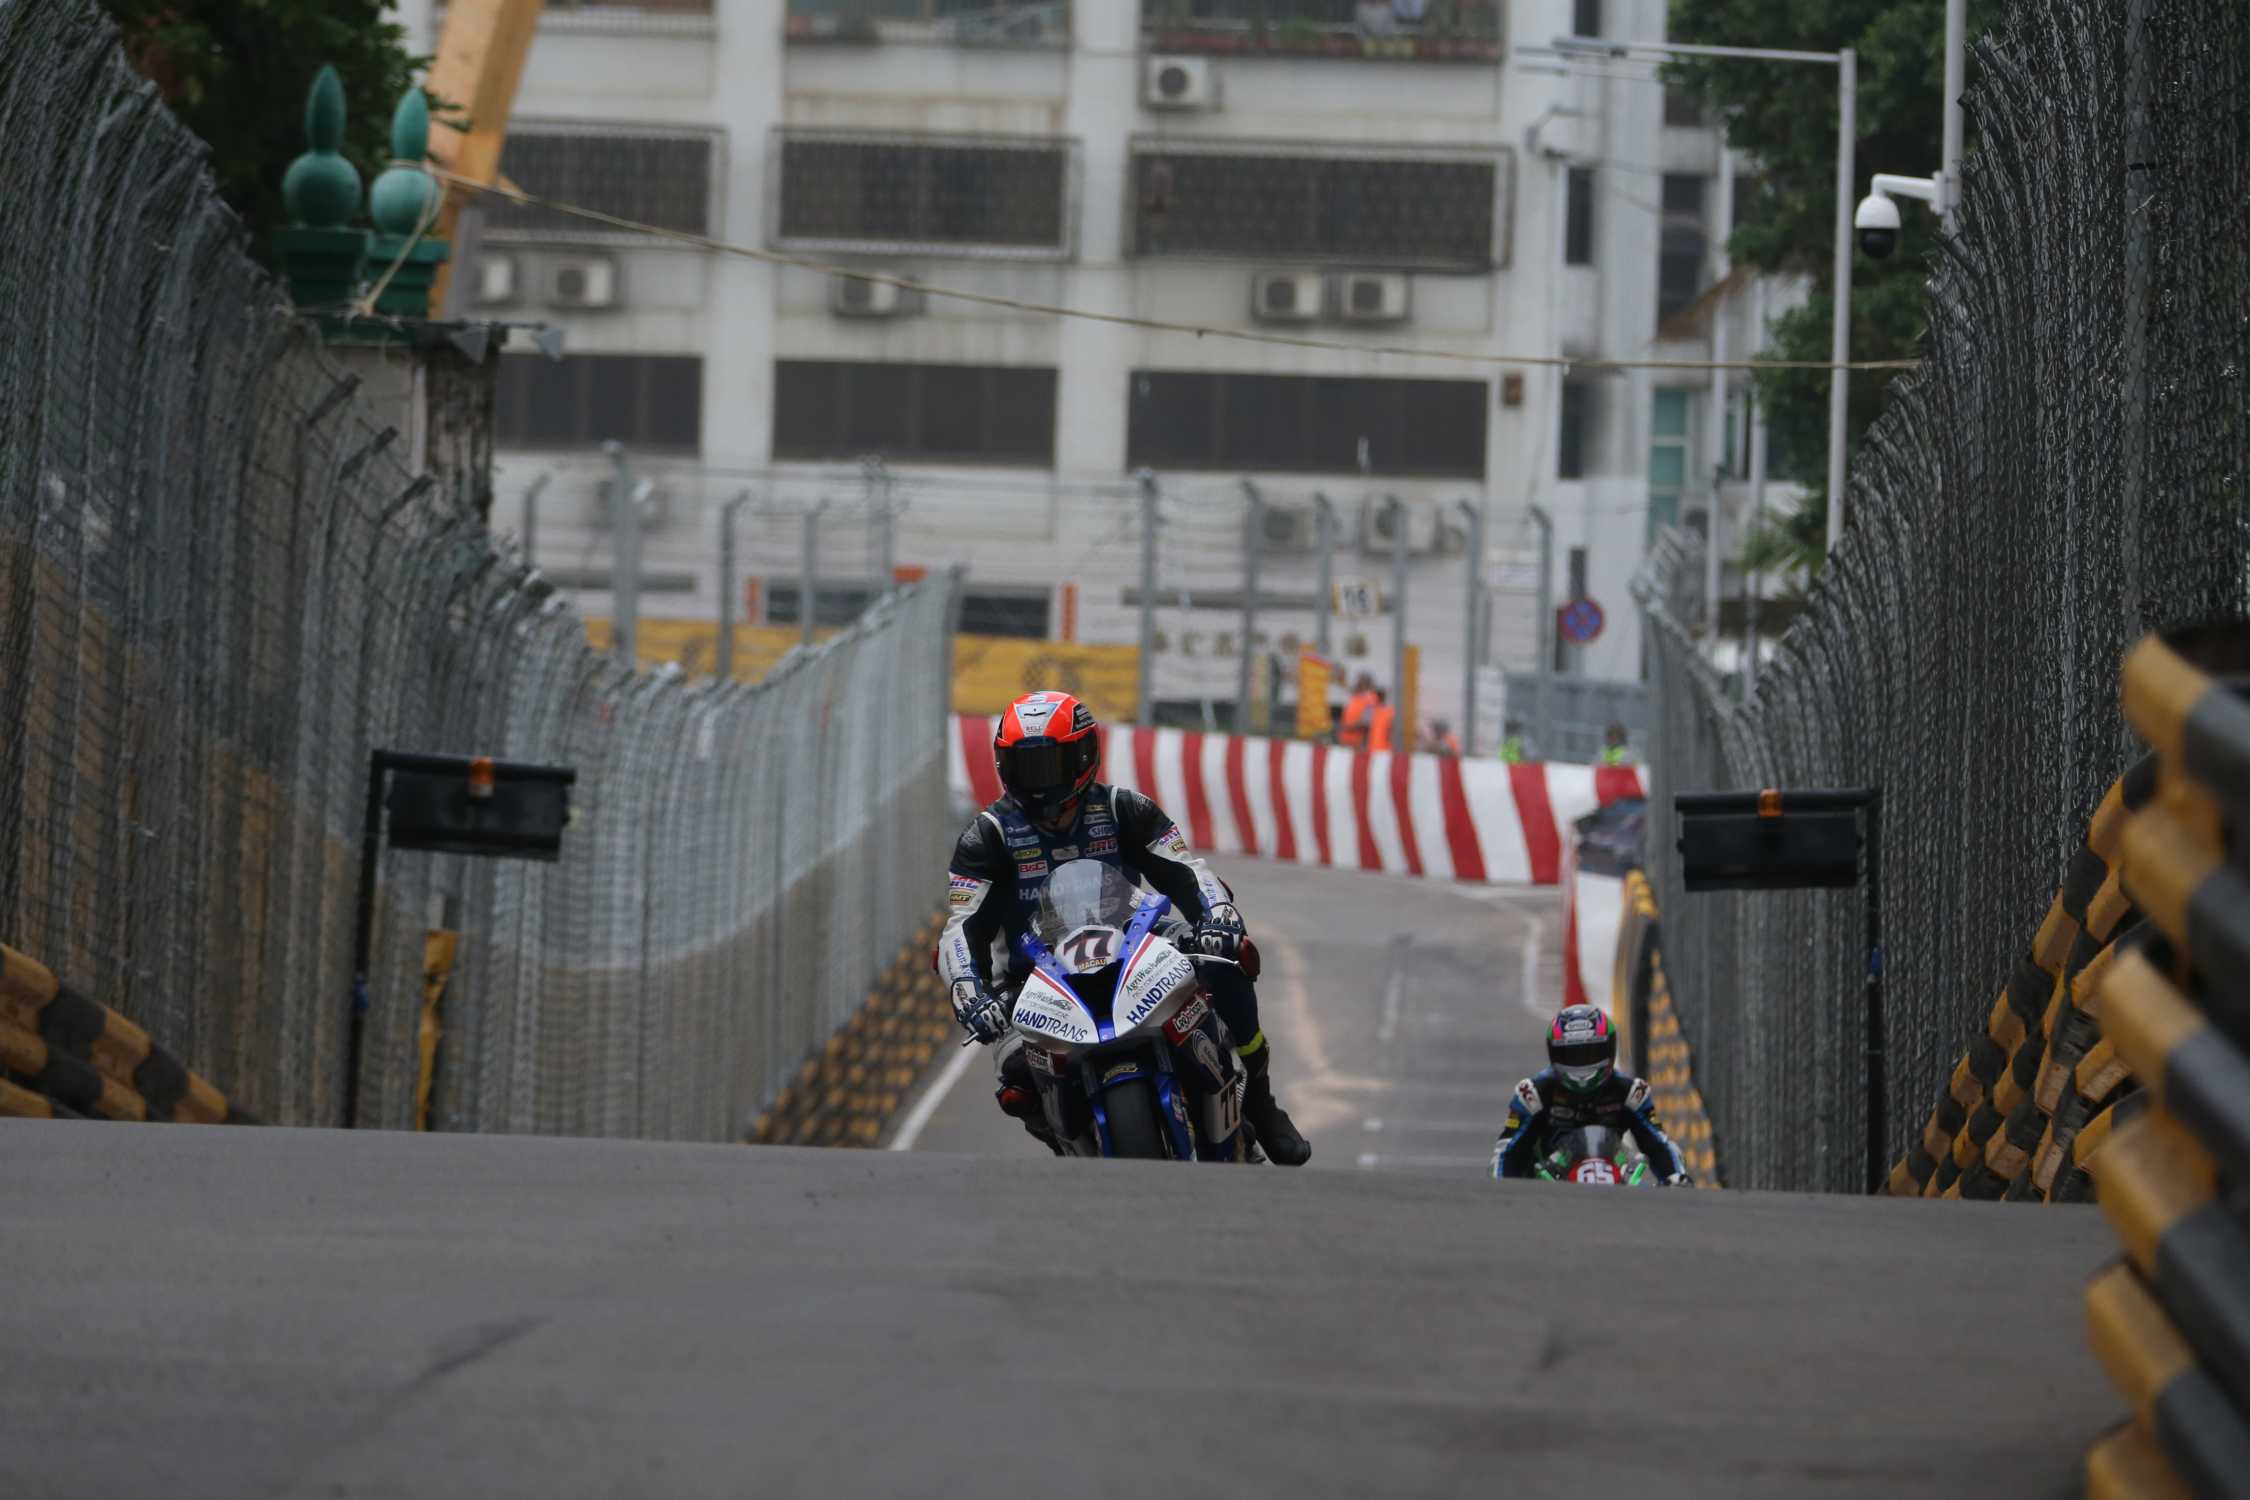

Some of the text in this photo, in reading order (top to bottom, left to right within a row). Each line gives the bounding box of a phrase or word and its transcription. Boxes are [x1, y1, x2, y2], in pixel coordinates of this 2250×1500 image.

[1063, 928, 1114, 965] 77
[1077, 957, 1108, 972] MACAU
[1126, 958, 1193, 1025] HANDTRANS
[1013, 1007, 1088, 1042] HANDTRANS
